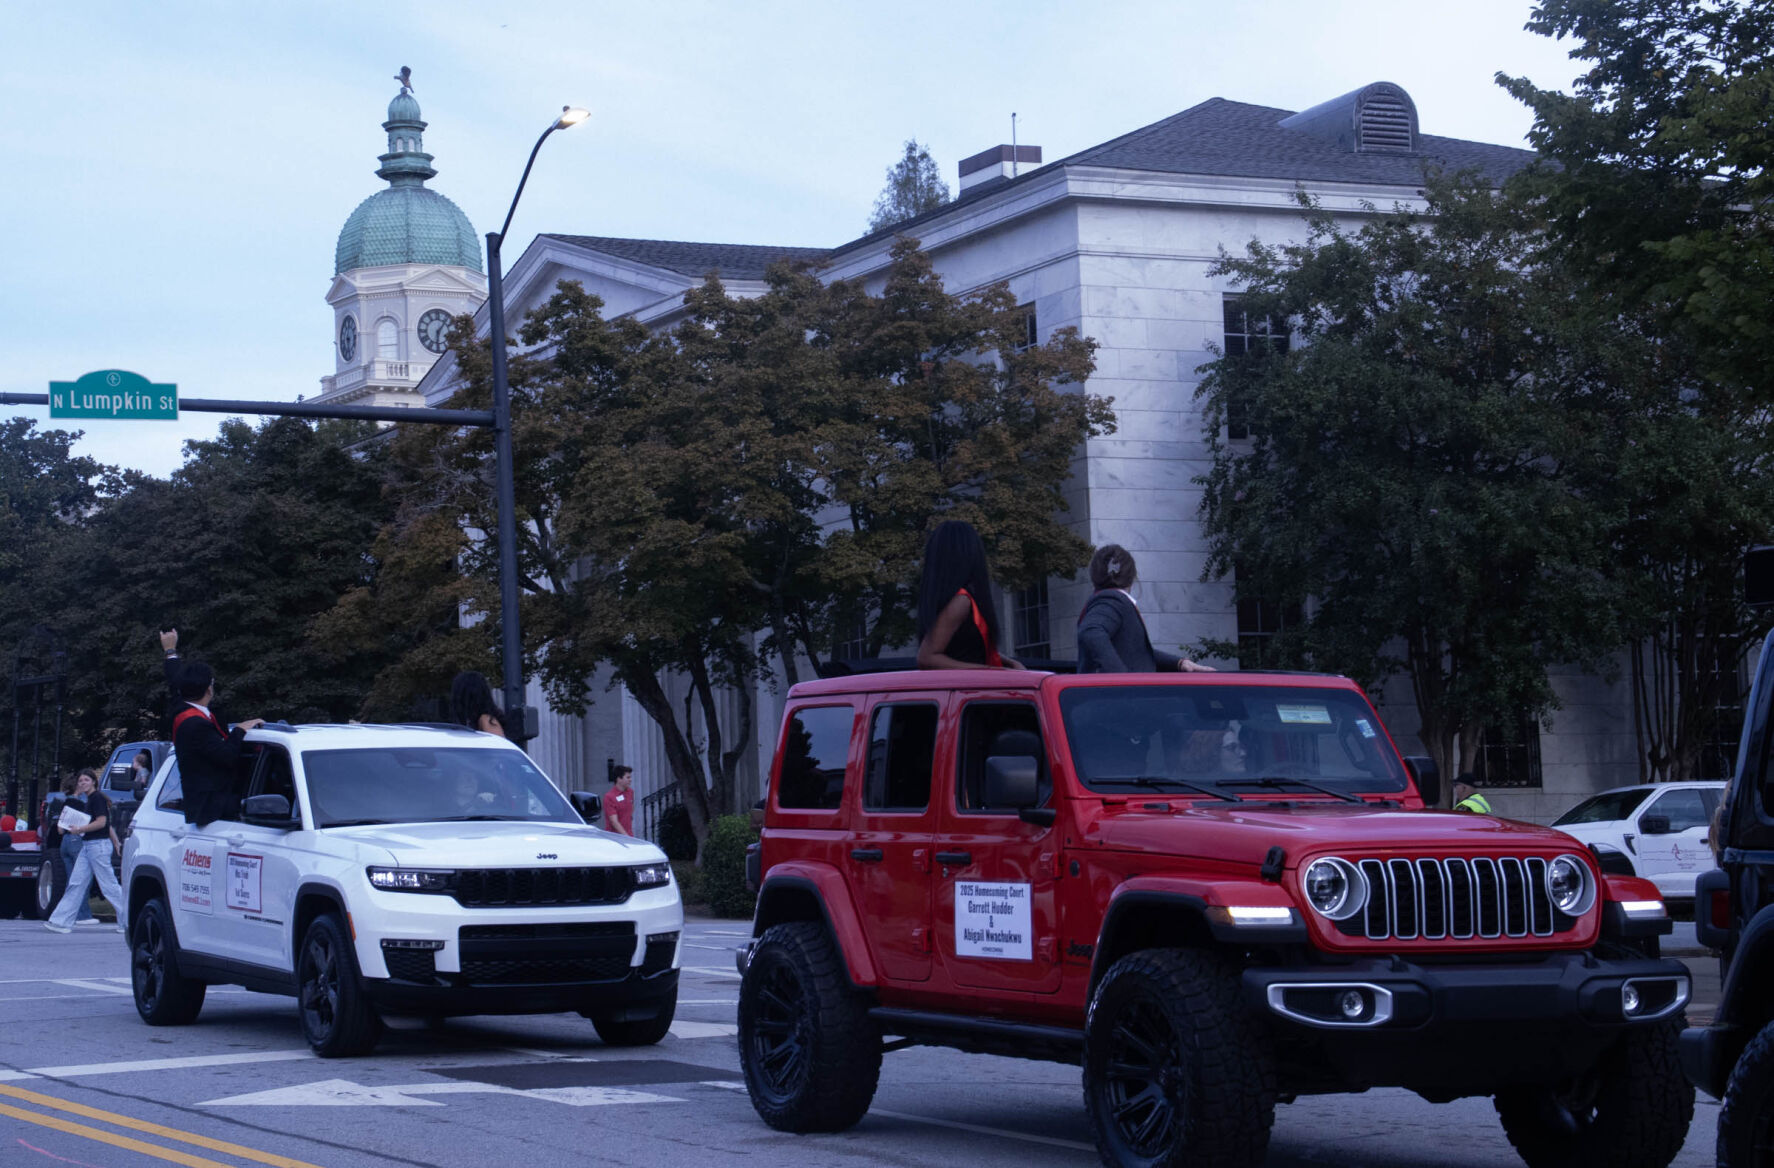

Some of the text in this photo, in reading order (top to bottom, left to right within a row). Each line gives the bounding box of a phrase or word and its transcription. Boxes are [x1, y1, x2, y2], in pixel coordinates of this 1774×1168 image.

[53, 390, 174, 416] N Lumpkin St
[182, 849, 212, 869] Athens
[960, 885, 1024, 900] 2025 Homecoming Court
[968, 900, 990, 914] Garrett
[989, 915, 994, 928] &
[964, 928, 985, 944] Abigail
